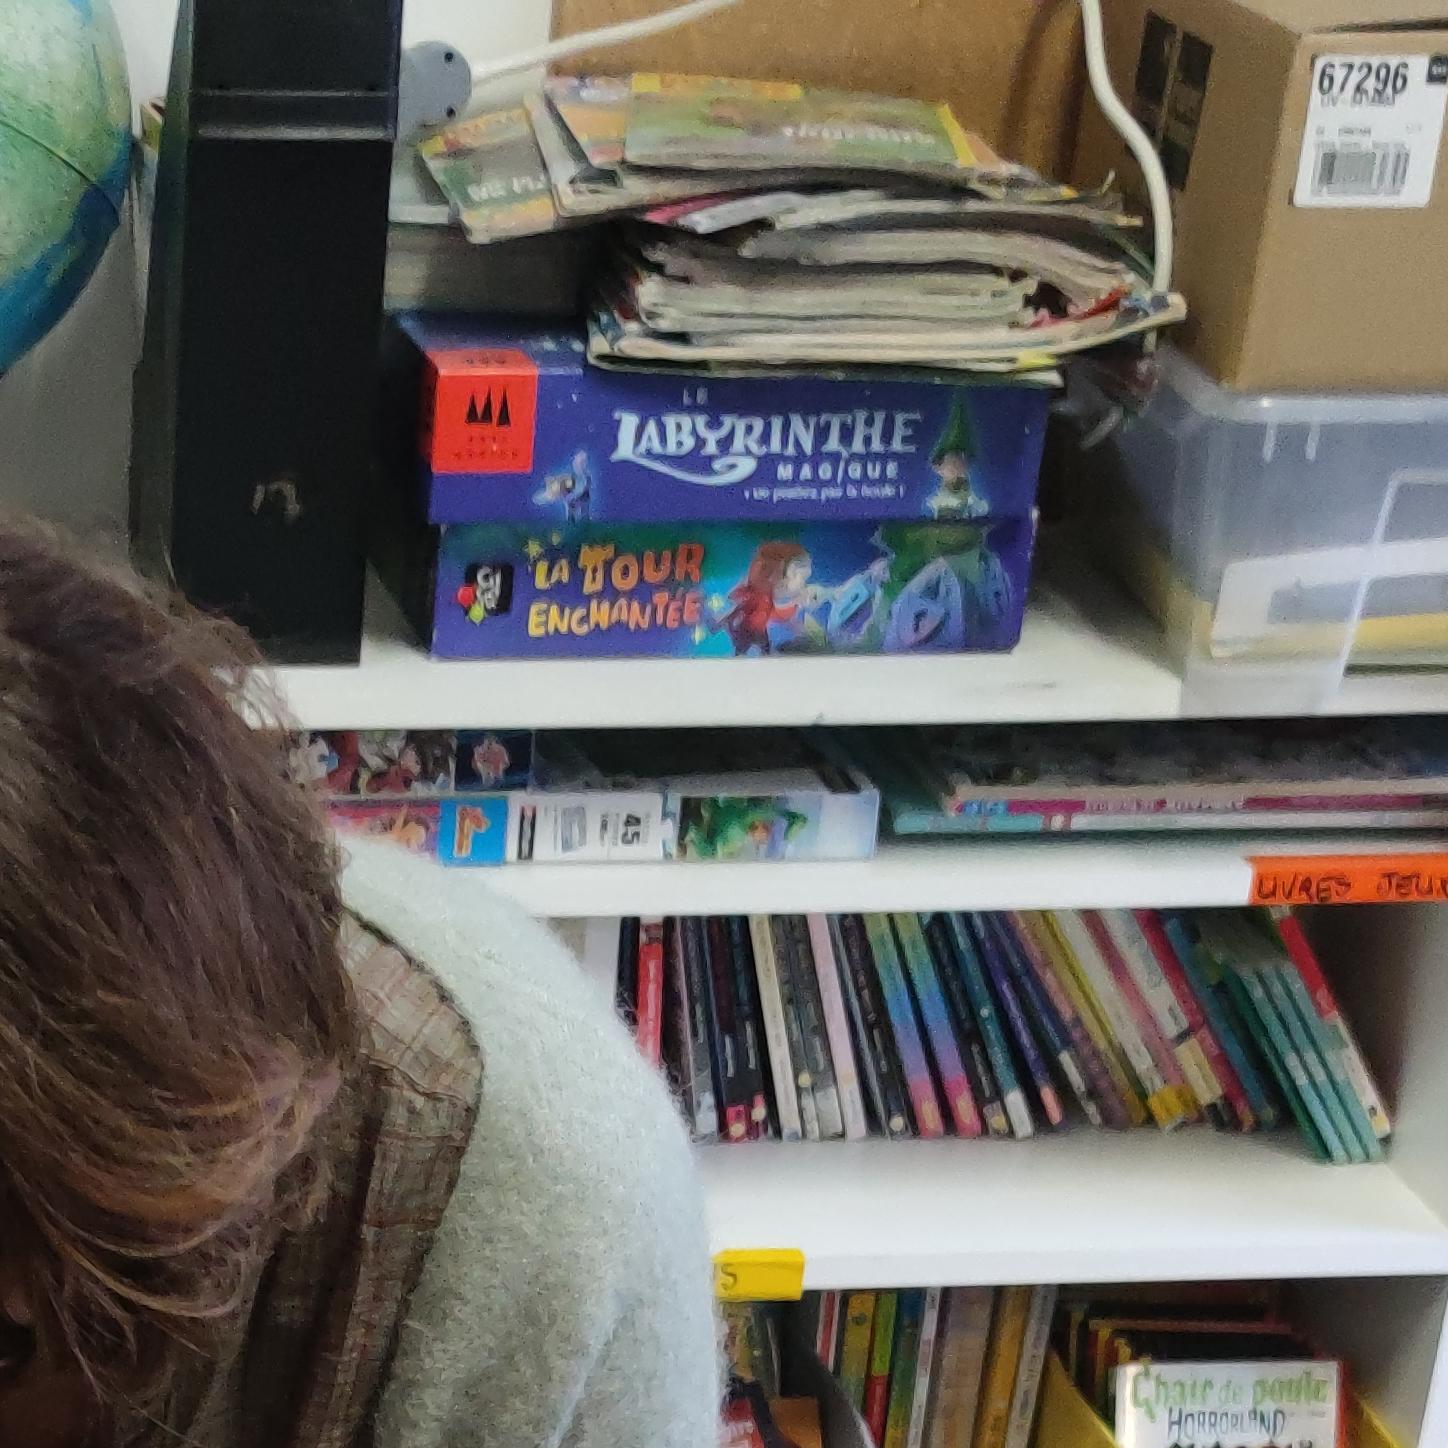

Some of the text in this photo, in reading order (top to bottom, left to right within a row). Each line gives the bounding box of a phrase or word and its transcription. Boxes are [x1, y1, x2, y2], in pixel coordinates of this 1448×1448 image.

[1319, 61, 1409, 96] 67296
[610, 410, 921, 485] LABYRINTHE
[534, 558, 569, 590] LA
[579, 544, 704, 595] TOUR
